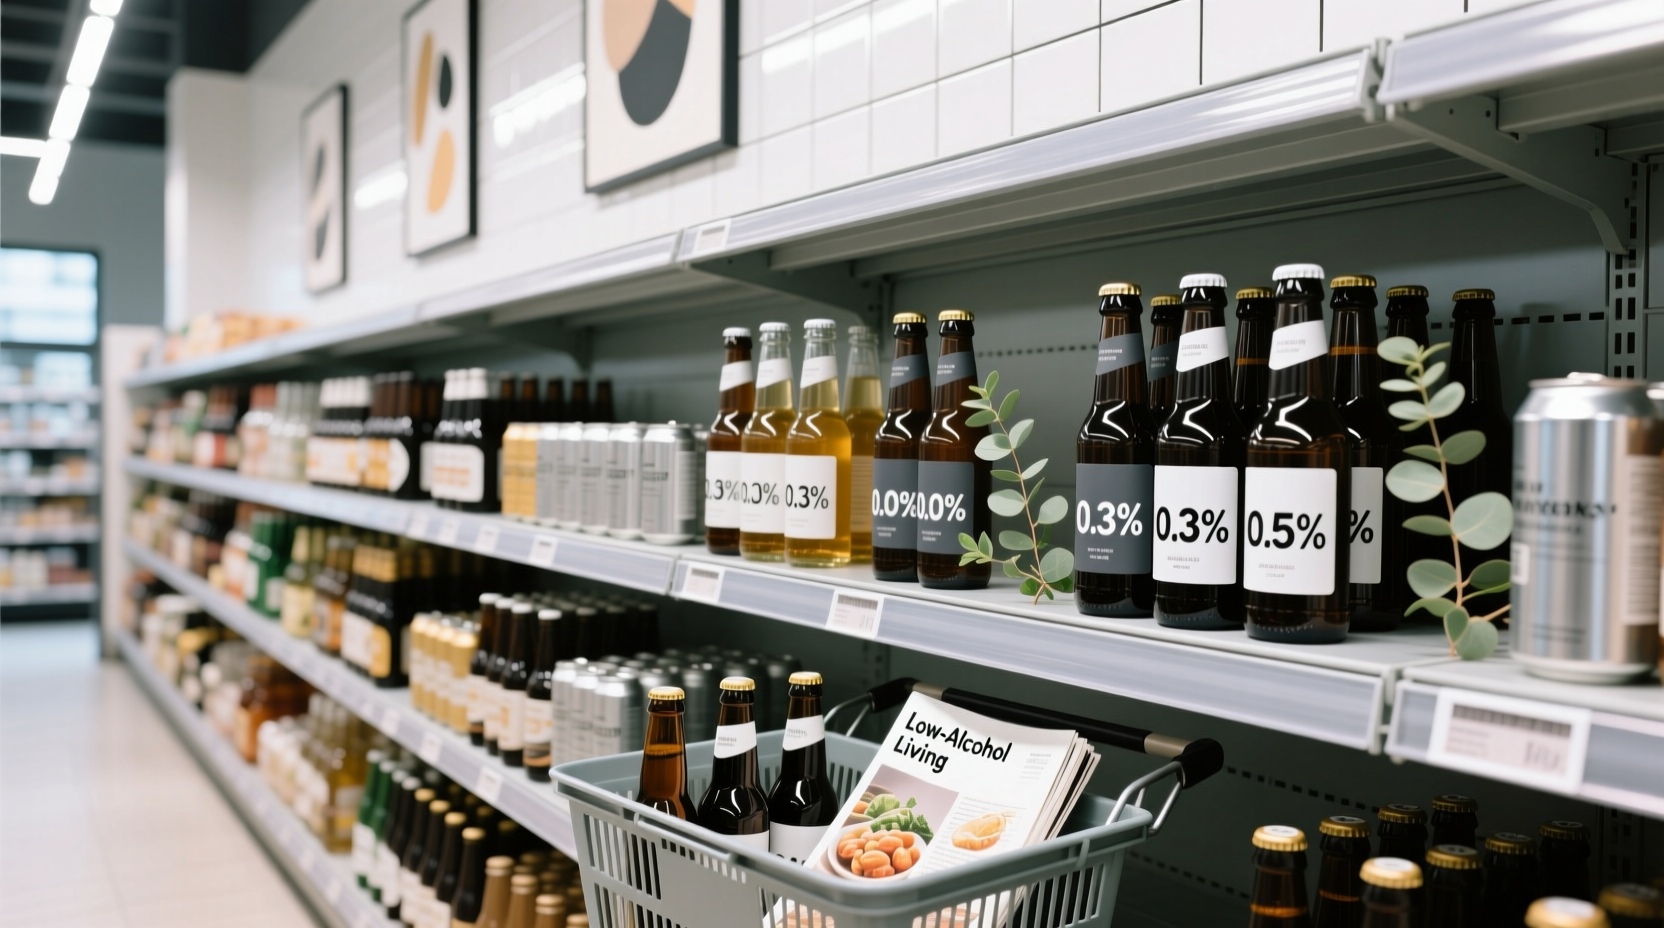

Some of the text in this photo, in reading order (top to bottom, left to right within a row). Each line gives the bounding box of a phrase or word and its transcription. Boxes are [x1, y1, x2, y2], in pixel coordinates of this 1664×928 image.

[785, 484, 829, 509] 0.3%
[872, 488, 917, 518] 0.0%
[917, 492, 967, 521] 0.0%
[1076, 500, 1143, 536] 0.3%
[1156, 506, 1229, 543] 0.3%
[1247, 510, 1326, 550] 0.5%
[893, 735, 949, 774] Living
[905, 711, 1013, 762] Low-Alcohol
